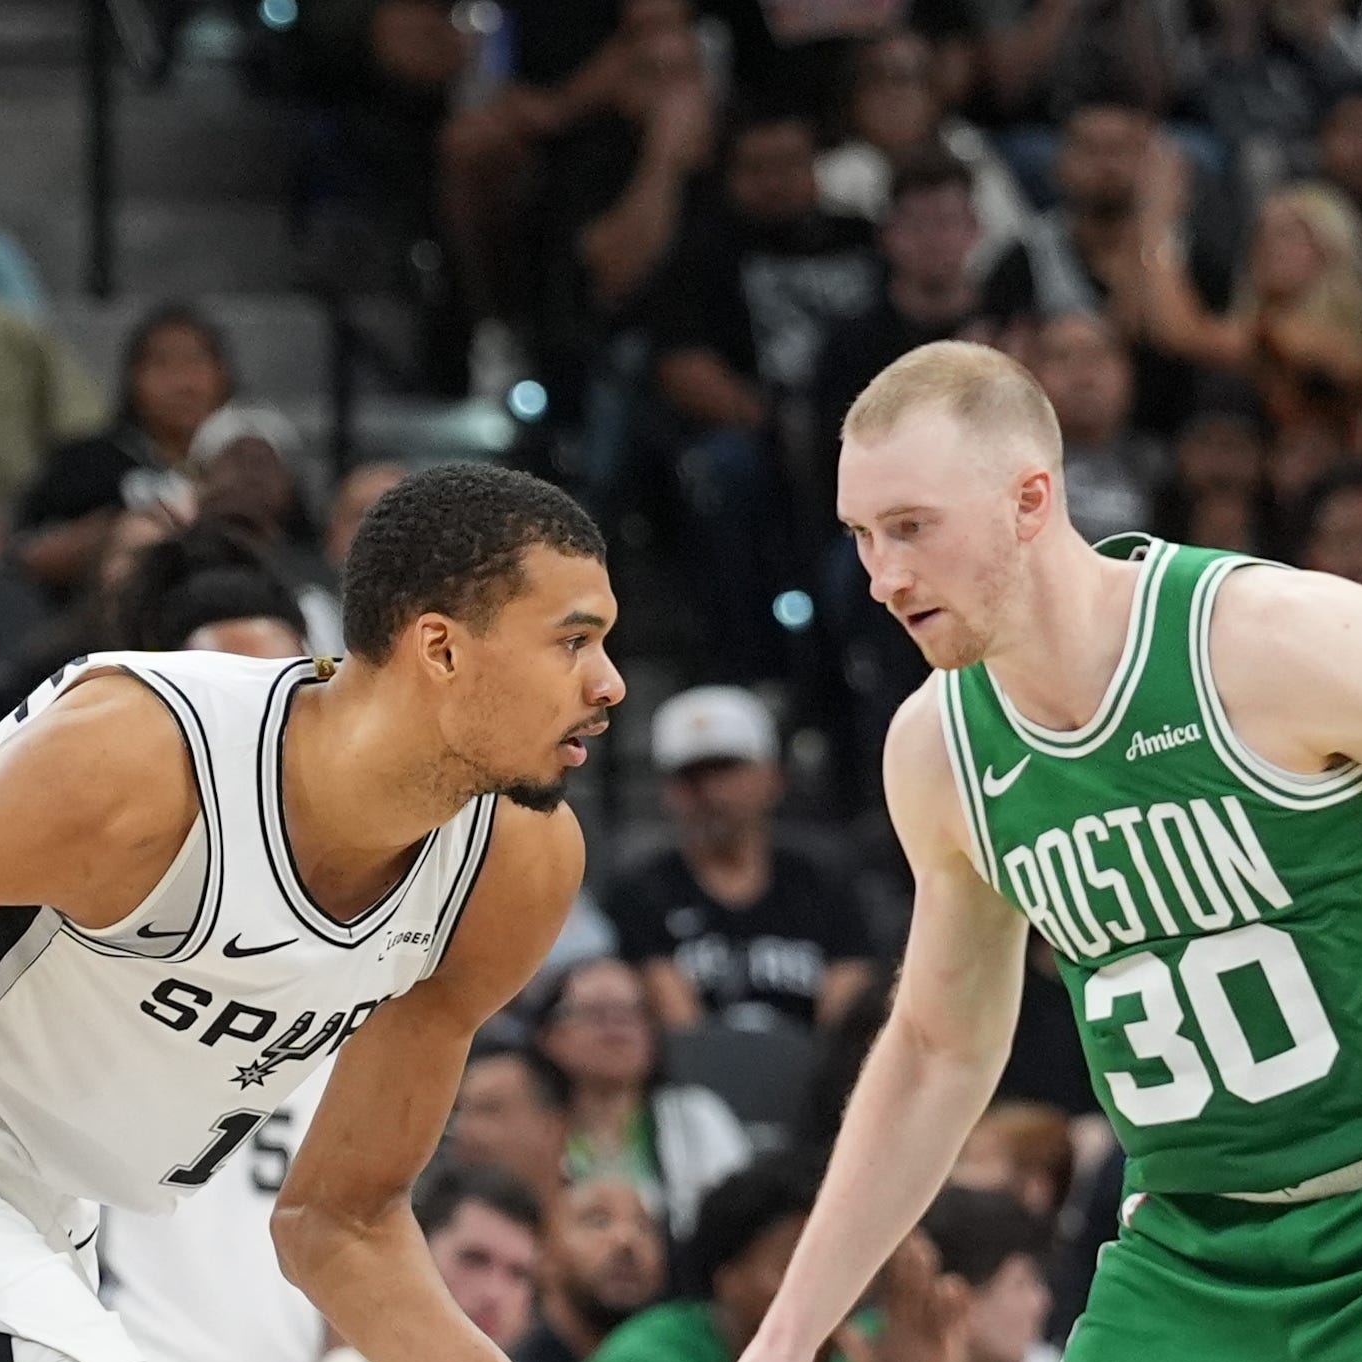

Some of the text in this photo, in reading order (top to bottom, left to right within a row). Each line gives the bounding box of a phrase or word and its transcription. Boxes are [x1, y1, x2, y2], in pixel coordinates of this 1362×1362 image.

[1125, 722, 1201, 761] Amica
[1002, 795, 1294, 964] BOSTON
[386, 931, 431, 950] LEDGER
[140, 977, 397, 1070] SPUR
[1084, 922, 1339, 1127] 30
[158, 1107, 269, 1188] 1
